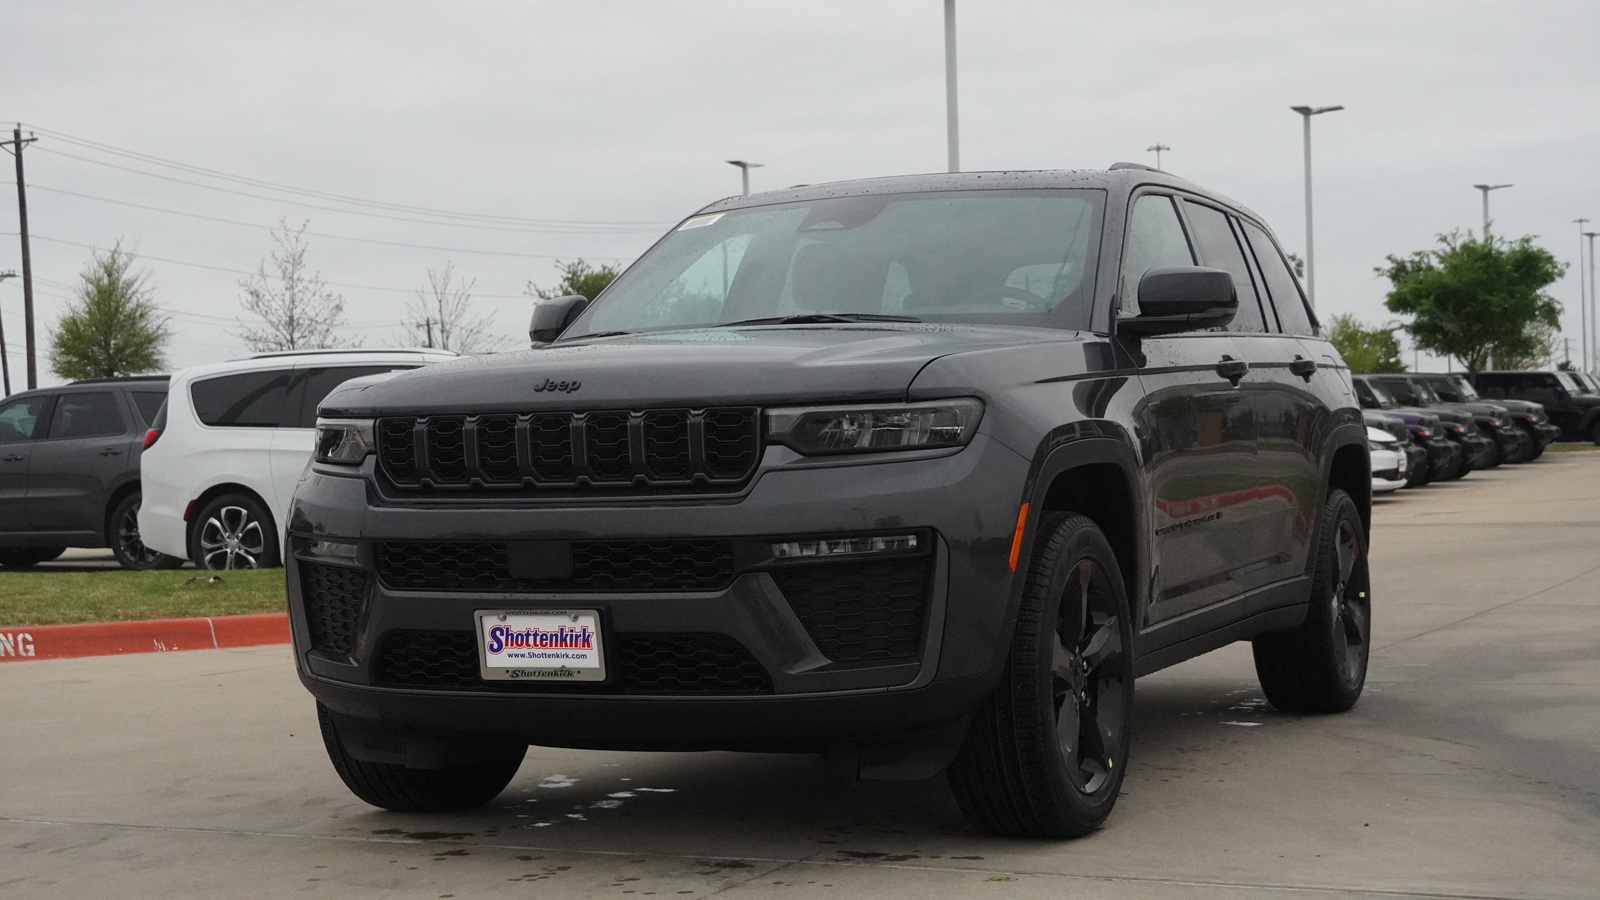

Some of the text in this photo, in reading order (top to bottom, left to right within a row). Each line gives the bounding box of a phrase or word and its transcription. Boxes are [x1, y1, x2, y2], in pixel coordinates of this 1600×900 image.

[533, 378, 582, 394] Jeep
[488, 625, 594, 655] Shottenkirk
[507, 652, 588, 660] www.Shottenkirk.com
[509, 669, 575, 678] Shottenkirk
